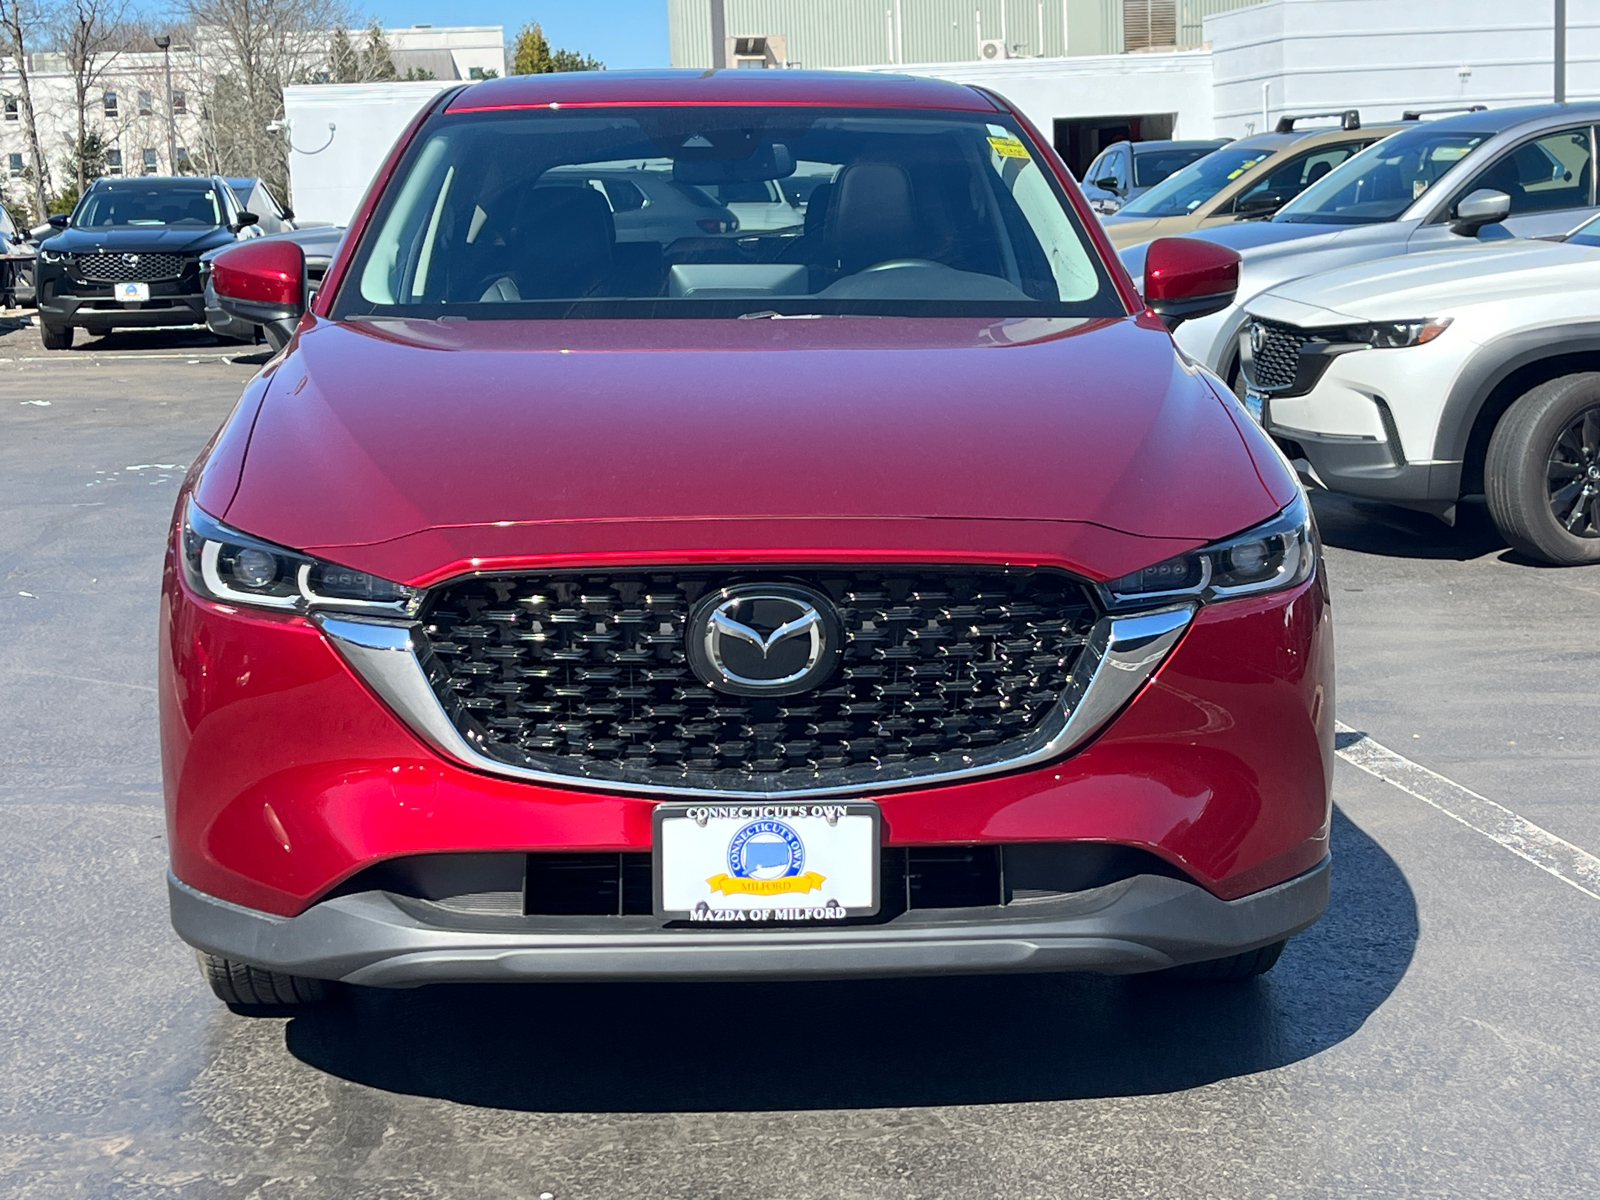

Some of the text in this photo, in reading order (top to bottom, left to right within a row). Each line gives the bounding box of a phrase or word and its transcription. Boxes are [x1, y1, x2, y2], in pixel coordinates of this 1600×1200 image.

[687, 805, 848, 818] CONNECTICUT'S OWN
[790, 840, 802, 869] OWN
[741, 882, 791, 891] MILFORD
[690, 907, 846, 921] MAZDA OF MILFORD
